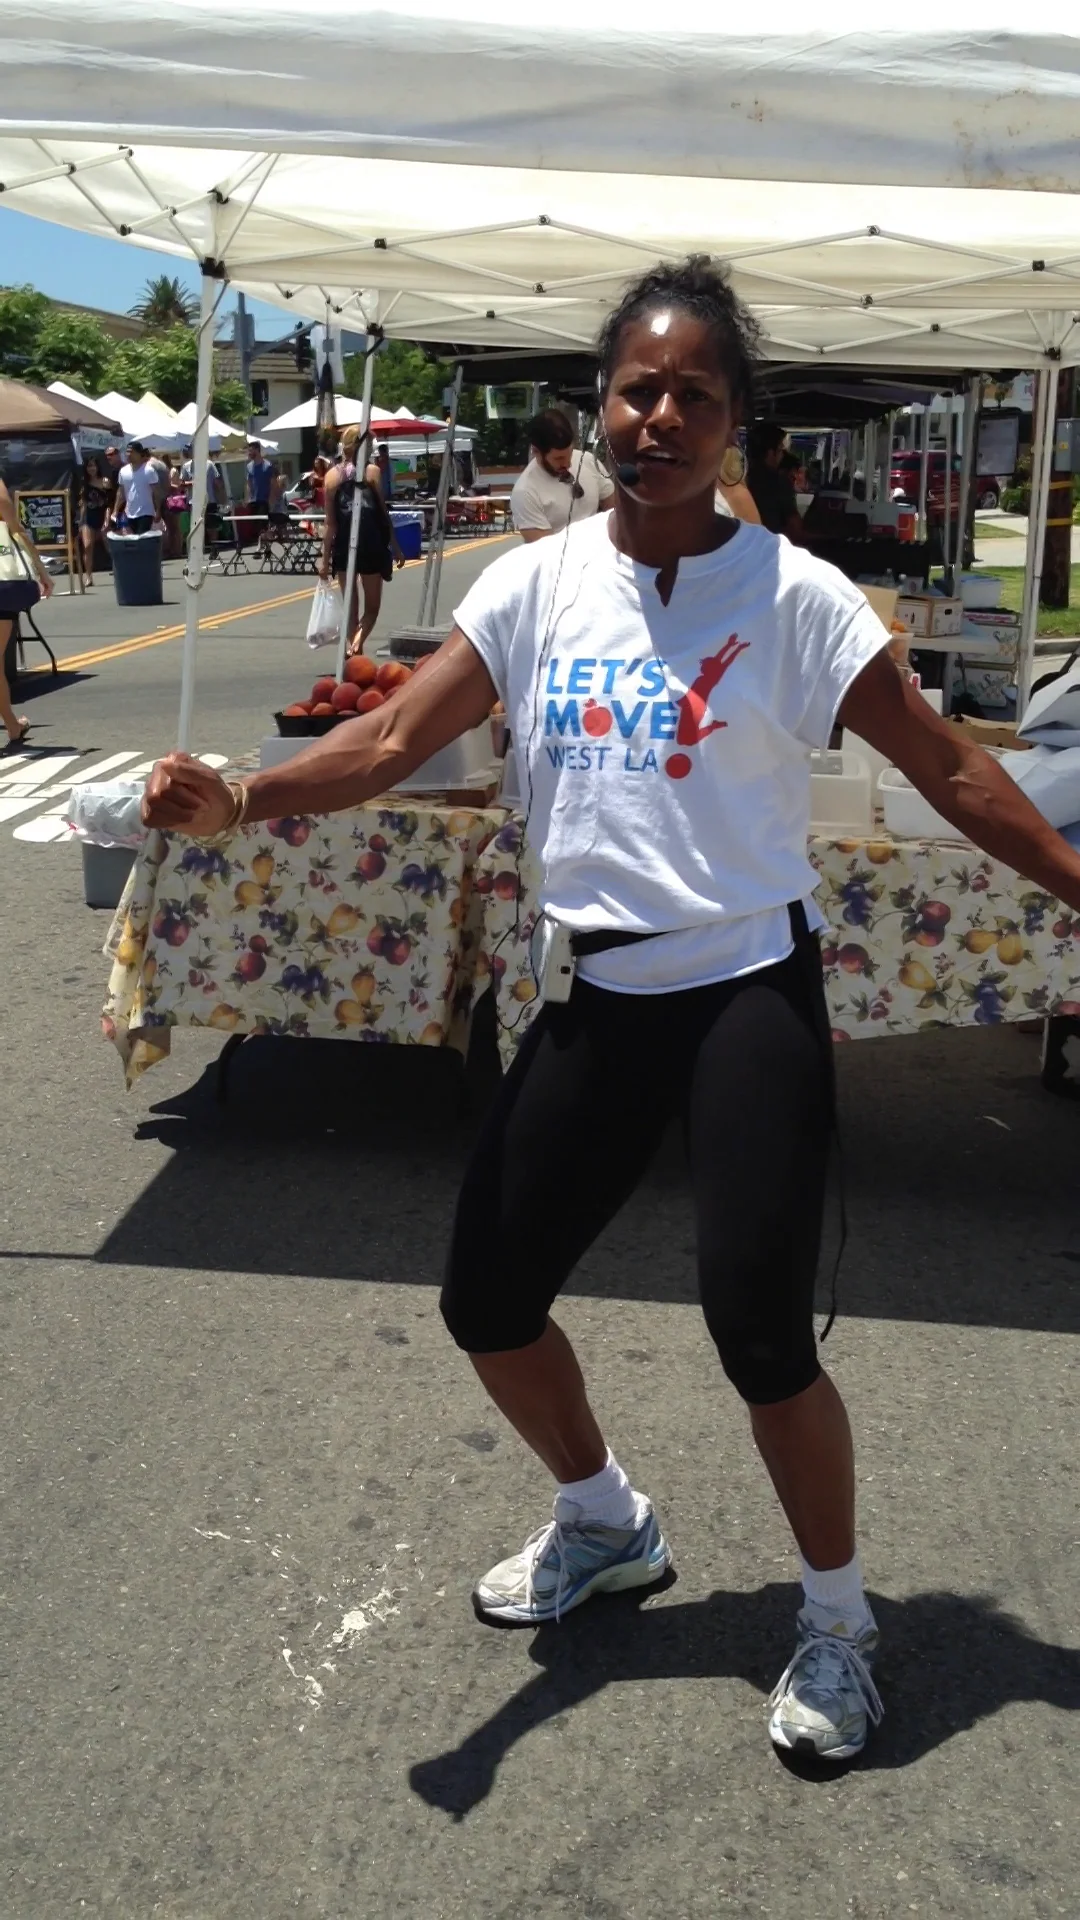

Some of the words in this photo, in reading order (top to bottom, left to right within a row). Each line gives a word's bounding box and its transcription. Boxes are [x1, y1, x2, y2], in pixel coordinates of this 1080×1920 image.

[546, 658, 667, 697] LET'S
[546, 746, 611, 770] WEST
[624, 748, 659, 773] LA
